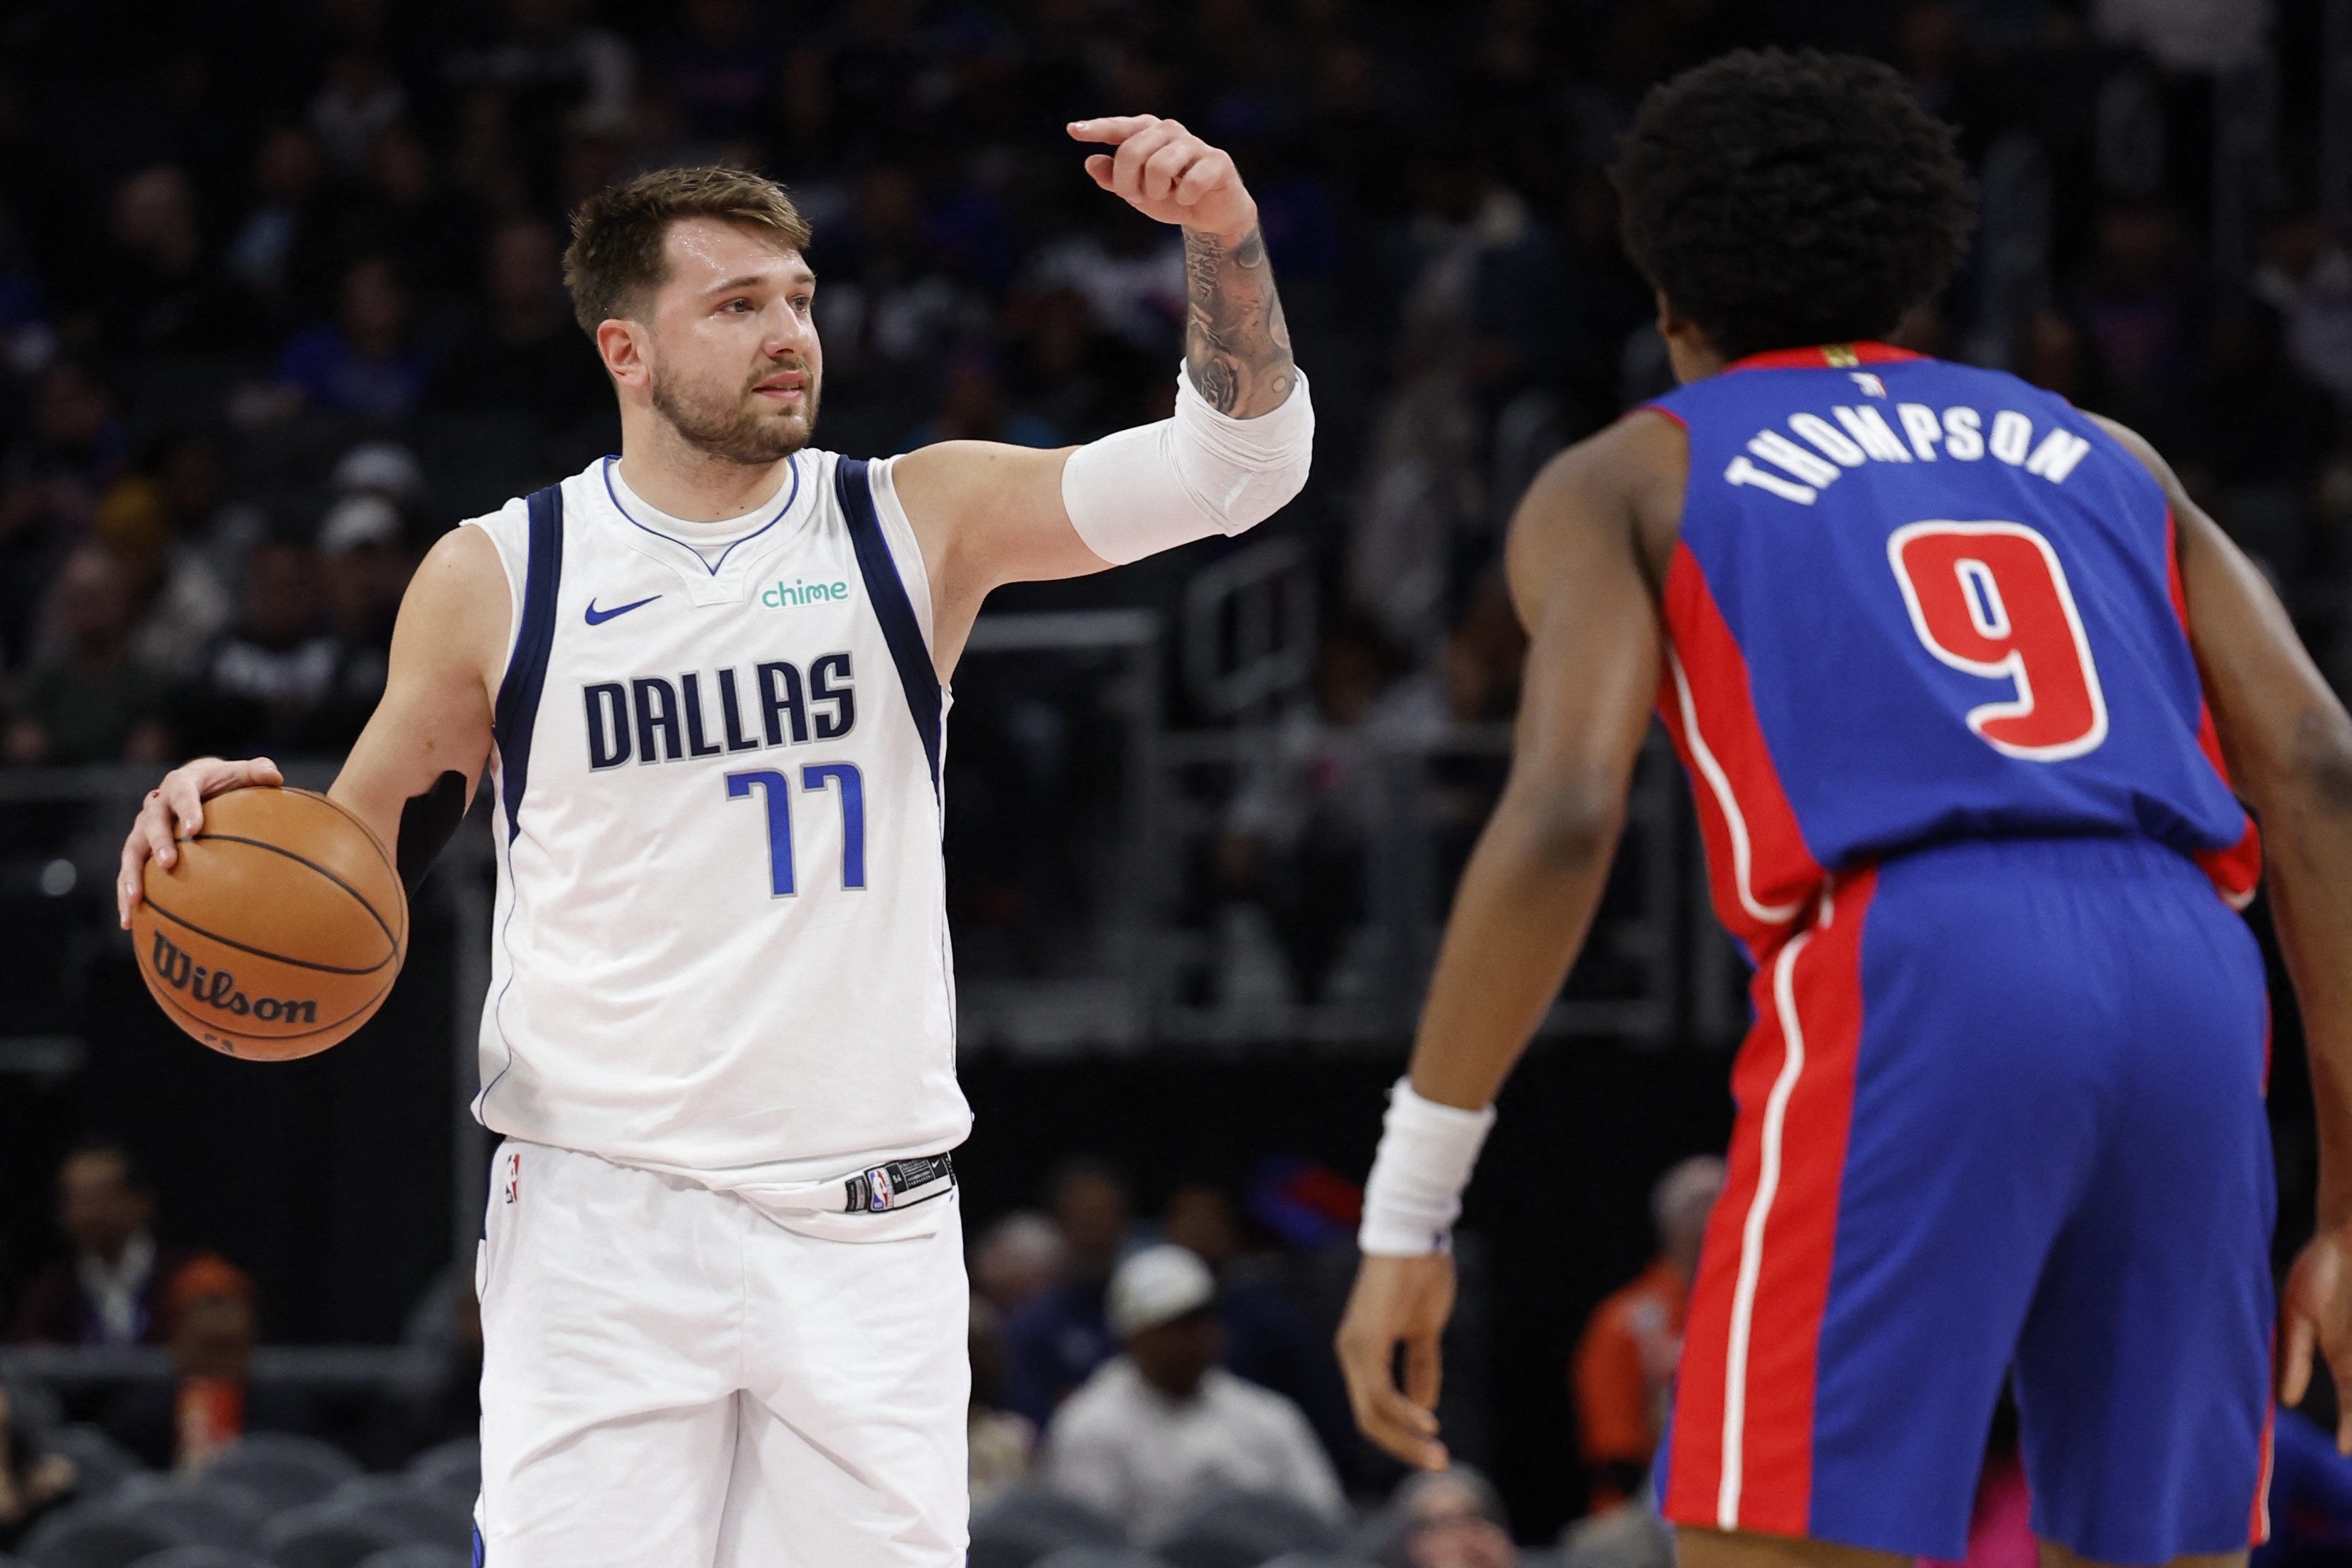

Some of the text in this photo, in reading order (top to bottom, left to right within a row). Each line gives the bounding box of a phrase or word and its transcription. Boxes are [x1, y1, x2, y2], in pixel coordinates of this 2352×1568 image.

[1724, 402, 2091, 506] THOMPSON
[762, 579, 849, 608] chime
[1886, 518, 2109, 762] 9
[581, 650, 858, 773] DALLAS
[723, 760, 867, 899] 77
[153, 928, 318, 1024] Wilson
